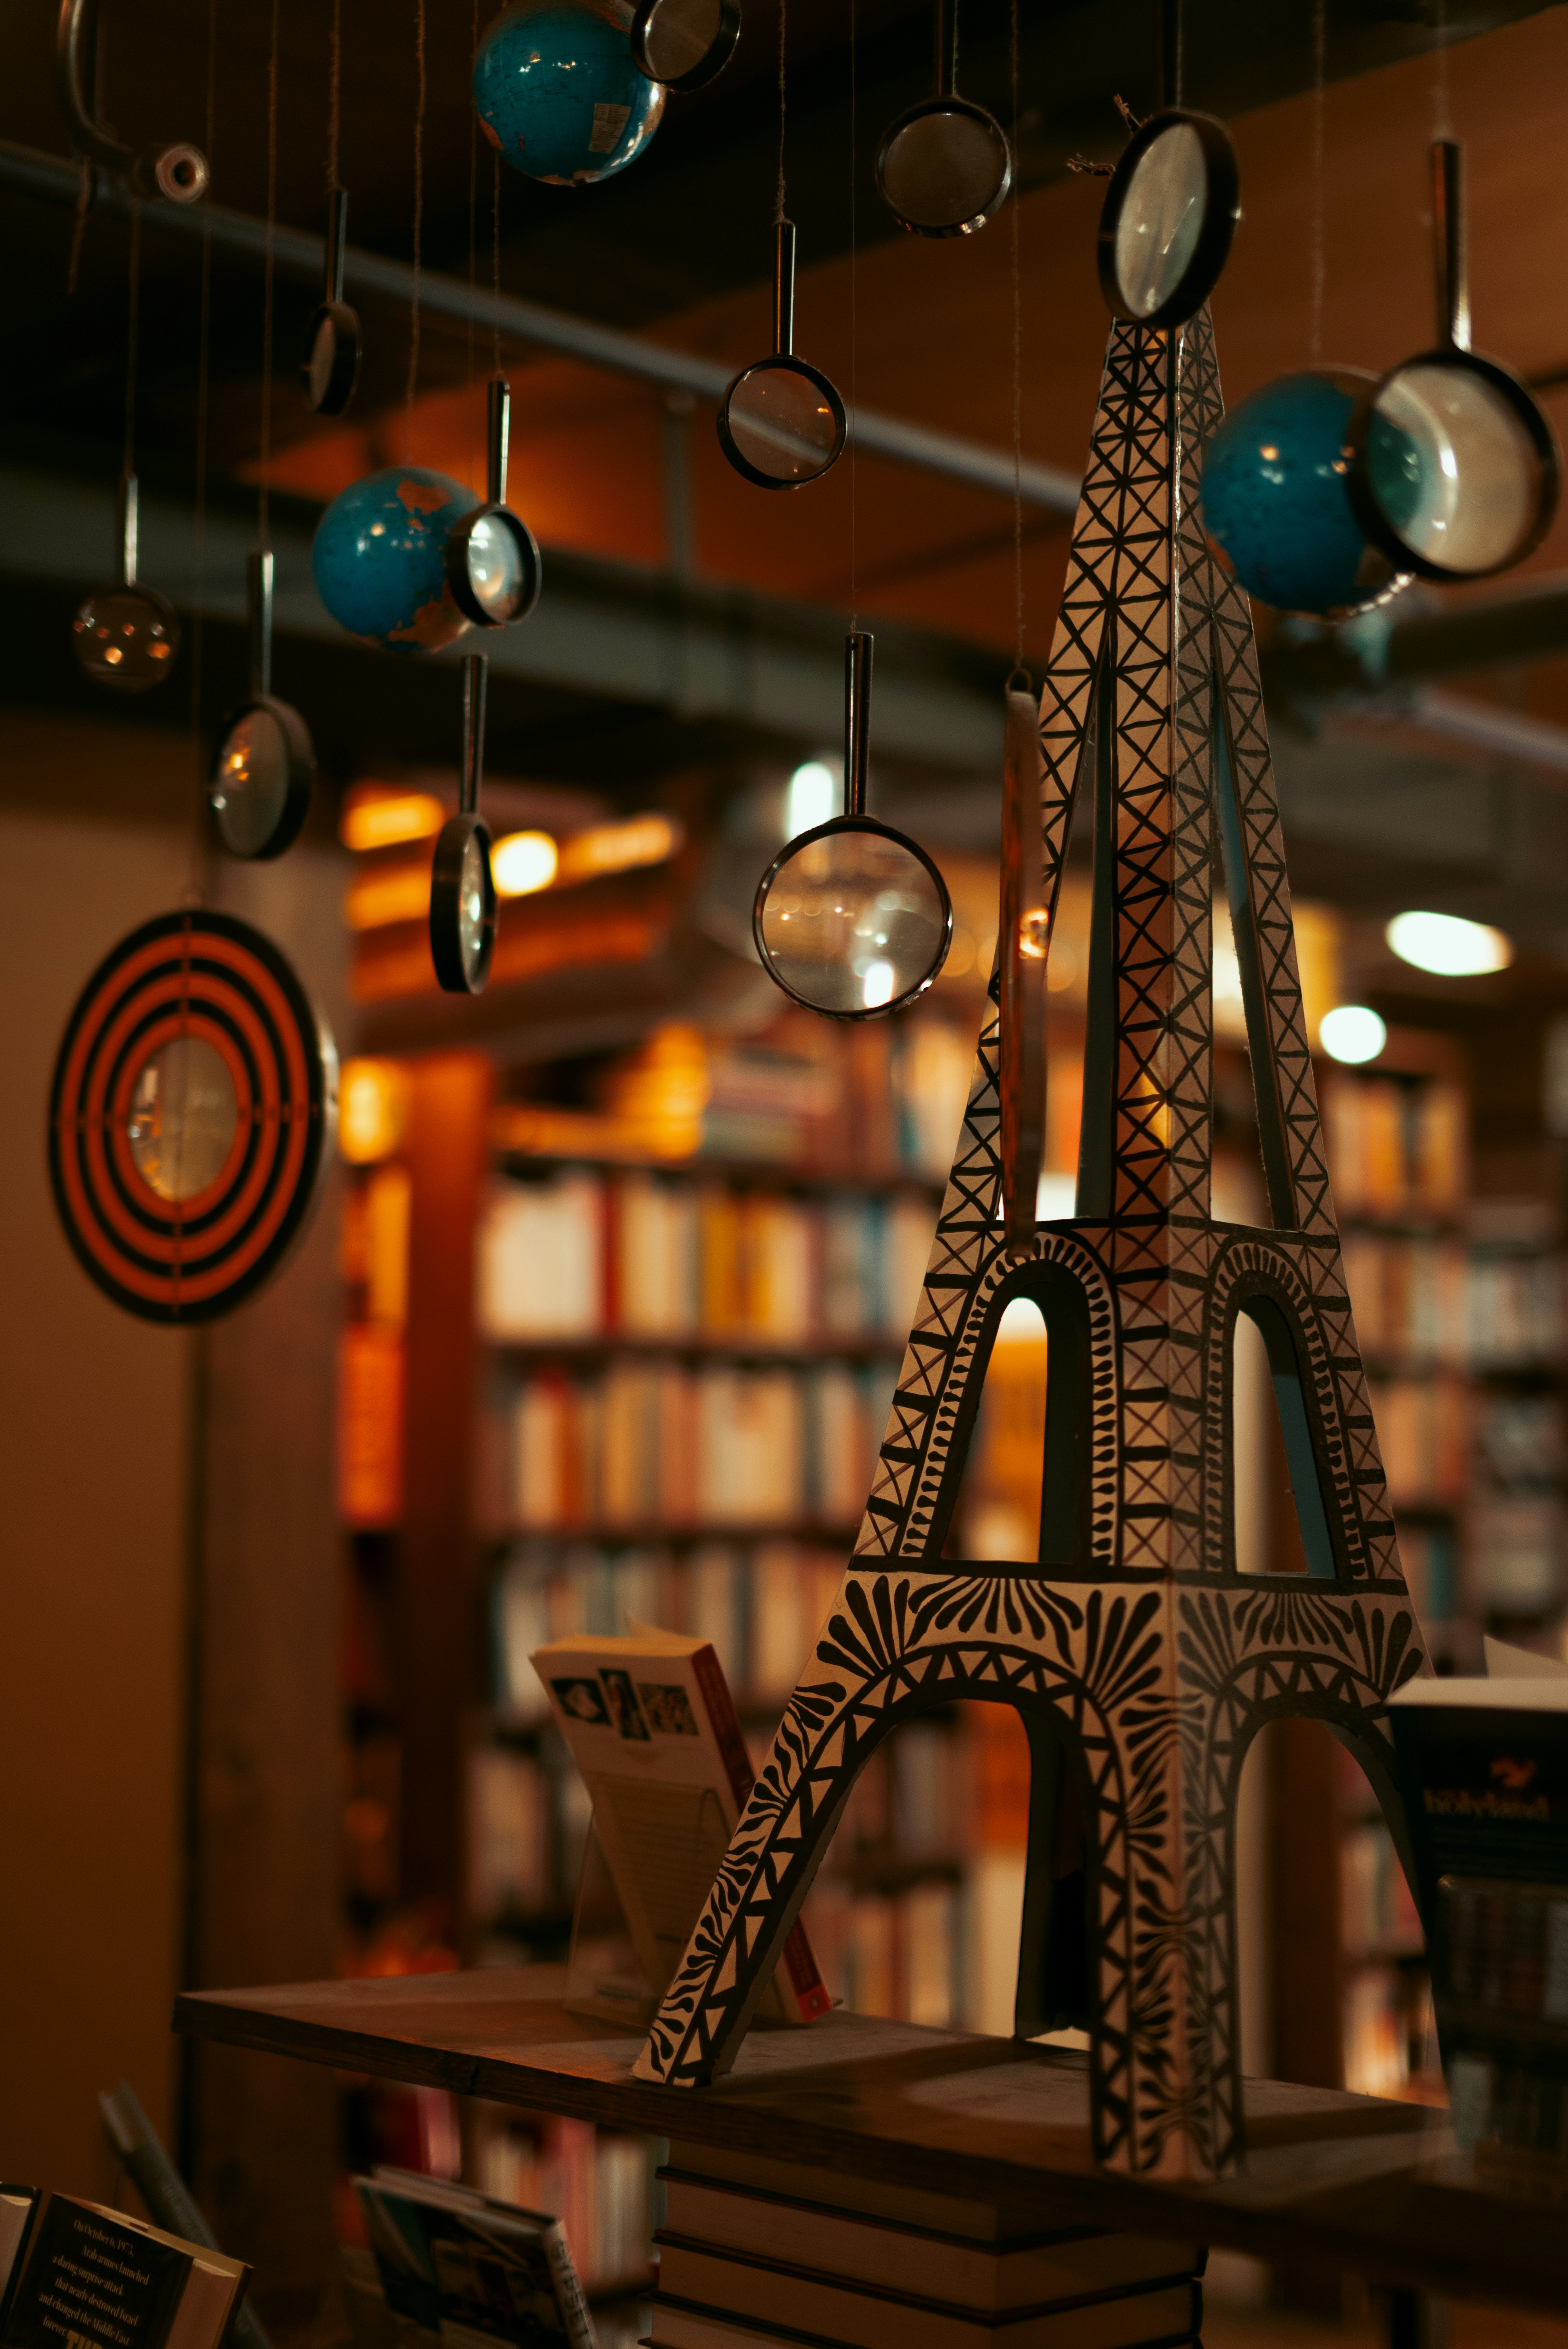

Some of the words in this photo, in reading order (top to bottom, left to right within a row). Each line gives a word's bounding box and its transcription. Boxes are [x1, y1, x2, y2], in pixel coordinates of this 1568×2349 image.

[74, 2219, 83, 2232] On
[84, 2226, 110, 2245] October
[109, 2237, 116, 2249] 6,
[118, 2239, 134, 2258] 1973,
[52, 2255, 57, 2263] a
[58, 2255, 78, 2277] daring
[78, 2266, 103, 2286] surprise
[104, 2280, 124, 2297] attack
[81, 2245, 97, 2260] Arab
[97, 2255, 119, 2271] armies
[119, 2262, 150, 2285] launched
[38, 2293, 52, 2307] and
[52, 2298, 80, 2319] changed
[80, 2313, 91, 2324] the
[92, 2317, 115, 2337] Middle
[115, 2331, 130, 2347] East
[55, 2277, 68, 2290] that
[68, 2285, 88, 2305] nearly
[88, 2293, 120, 2318] destroyed
[120, 2309, 139, 2327] Israel
[42, 2315, 66, 2337] forever.
